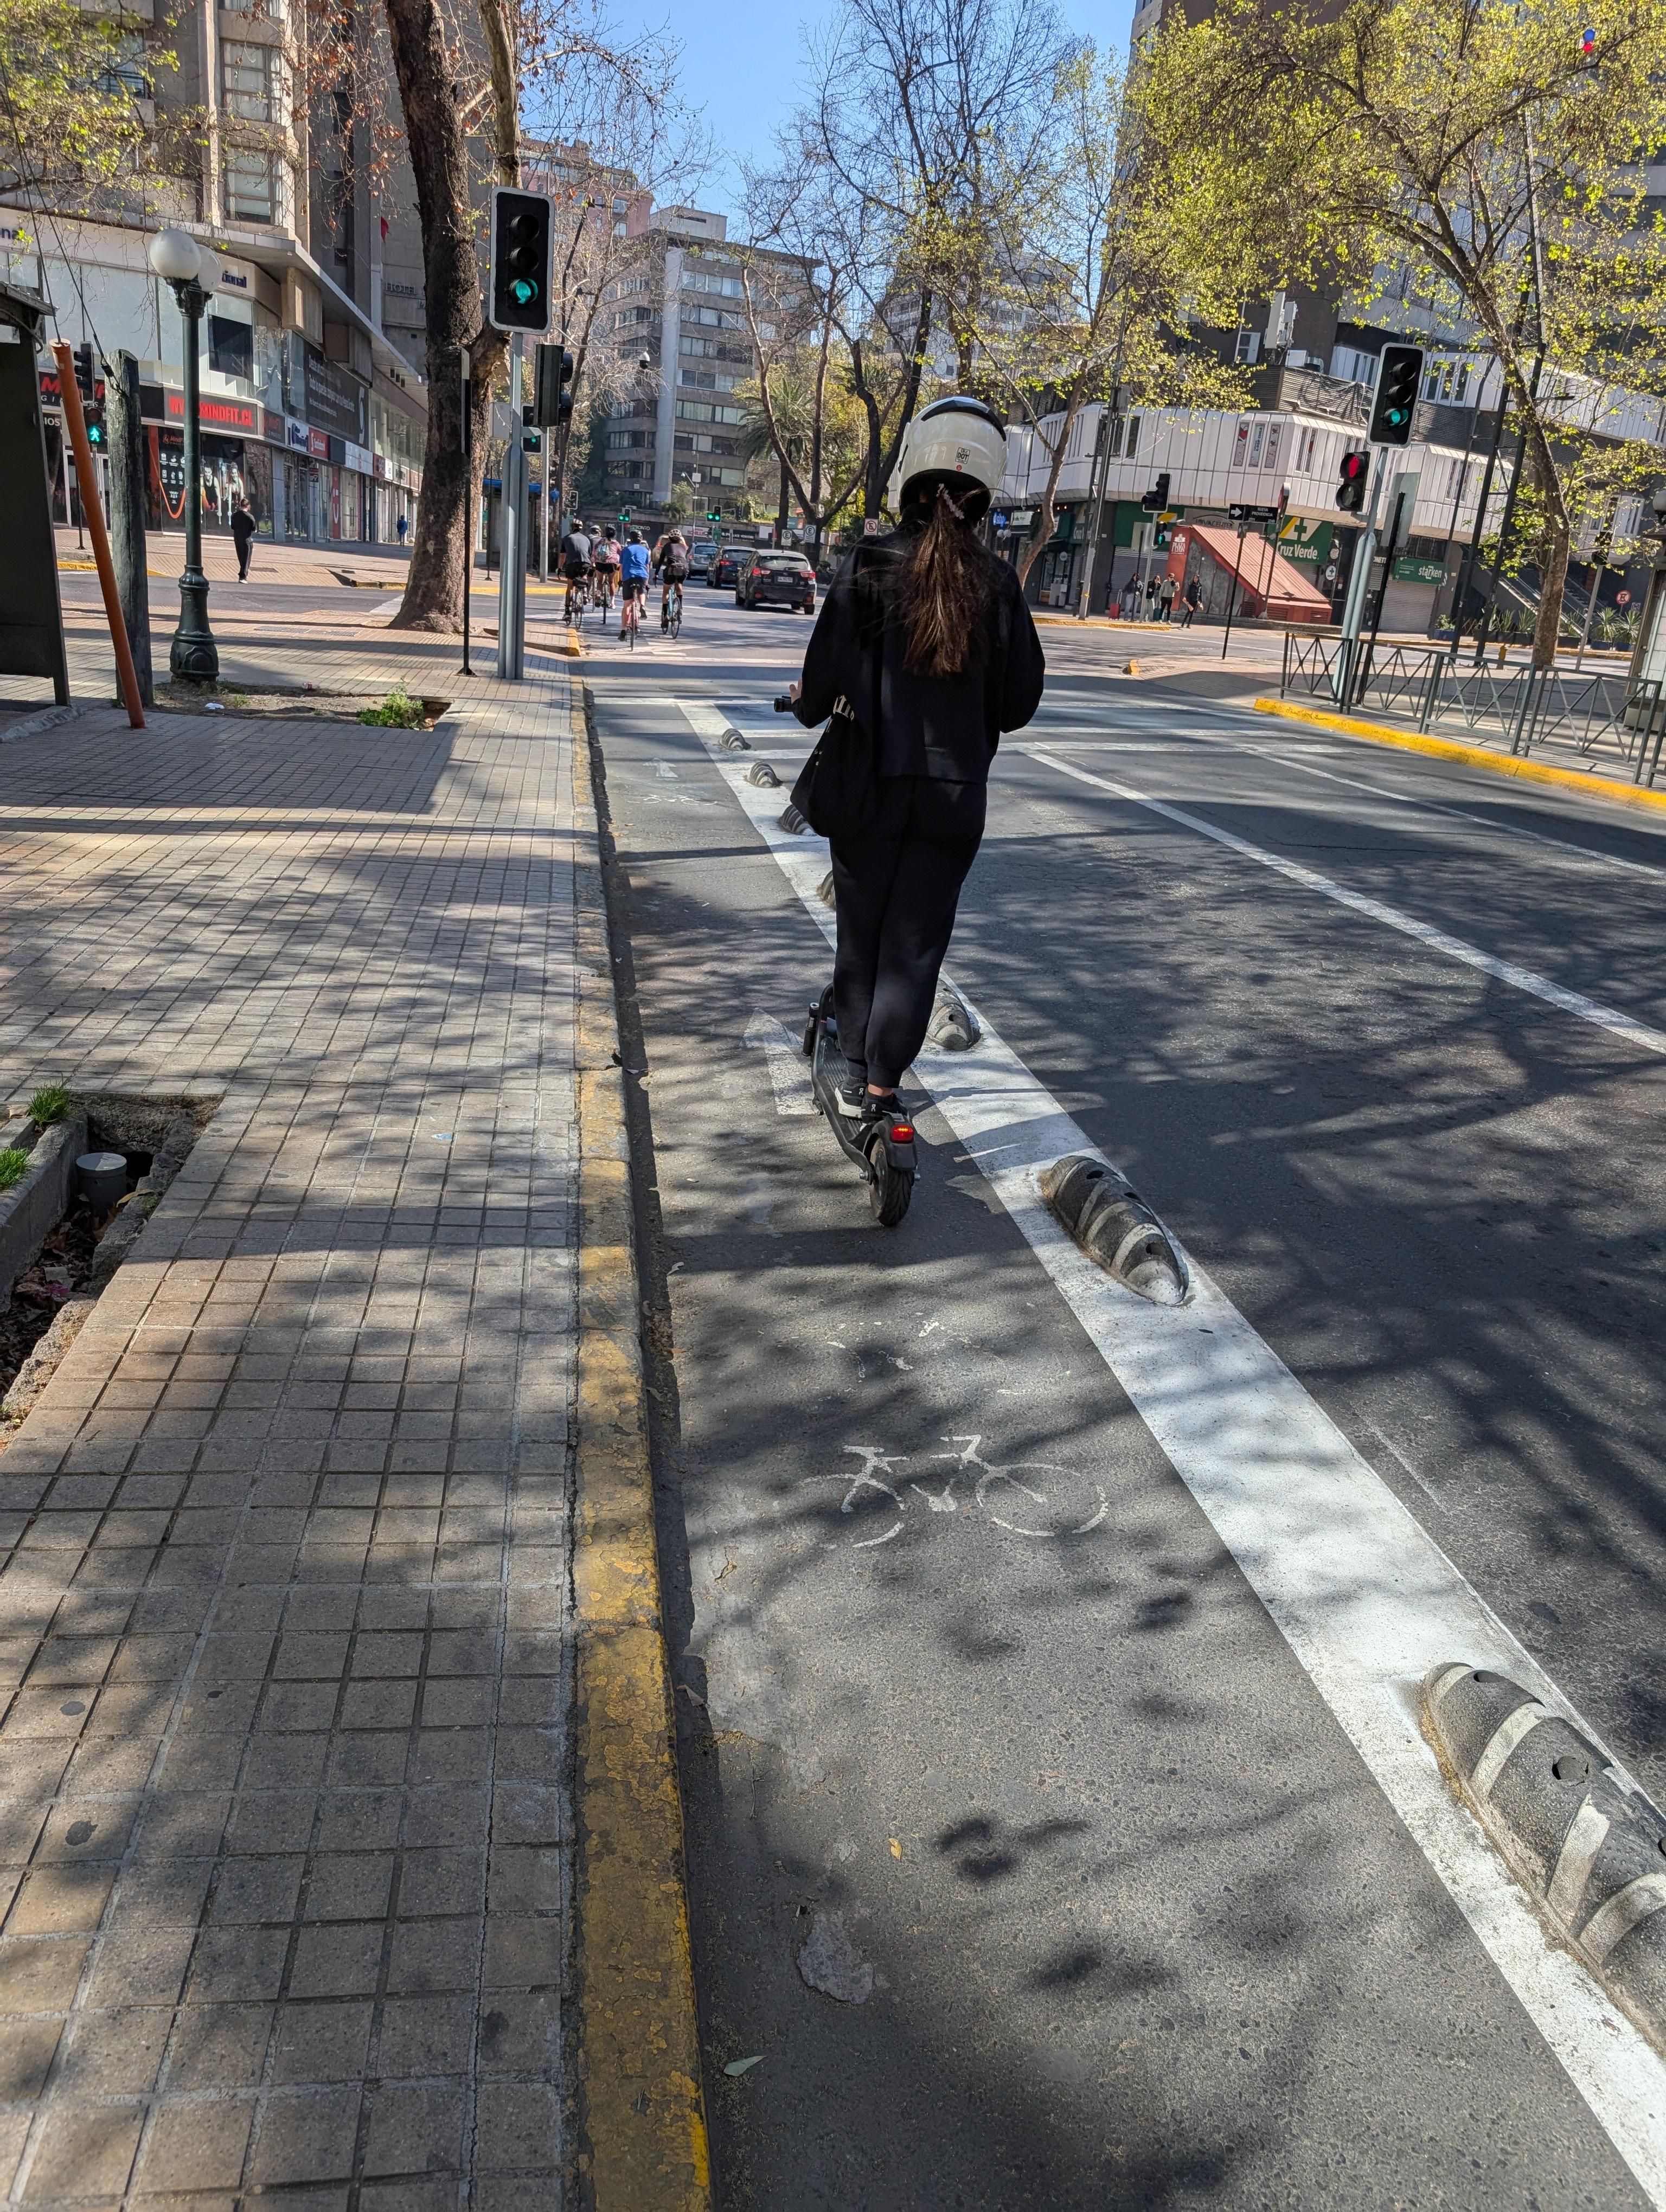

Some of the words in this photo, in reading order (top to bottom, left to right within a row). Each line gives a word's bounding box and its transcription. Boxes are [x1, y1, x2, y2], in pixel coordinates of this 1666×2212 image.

[957, 452, 969, 460] DOT
[1276, 541, 1294, 557] Cruz
[1294, 544, 1318, 560] Verde
[1418, 565, 1443, 580] starken
